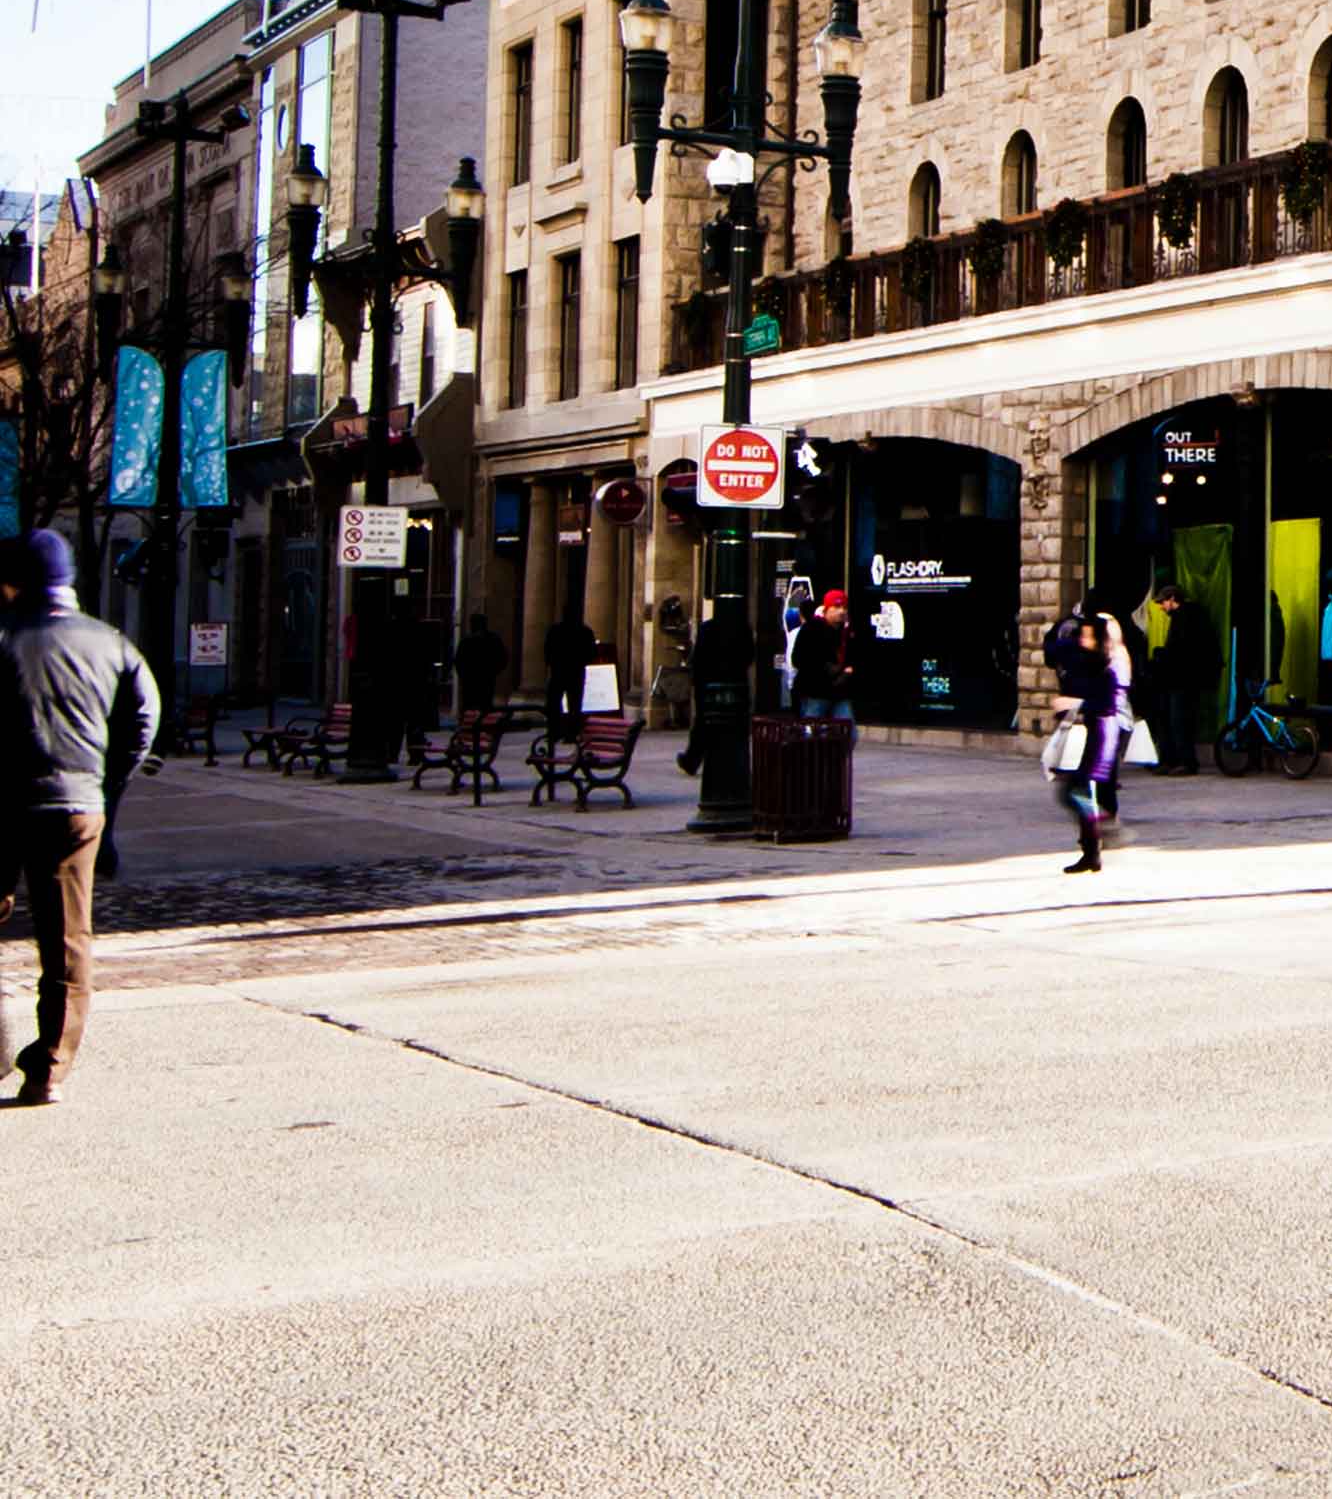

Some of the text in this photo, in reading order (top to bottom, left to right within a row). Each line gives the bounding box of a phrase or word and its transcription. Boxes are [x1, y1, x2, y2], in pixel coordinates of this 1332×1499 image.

[1164, 431, 1192, 444] OUT
[716, 444, 769, 459] DO NOT
[1163, 447, 1216, 463] THERE
[719, 473, 764, 488] ENTER
